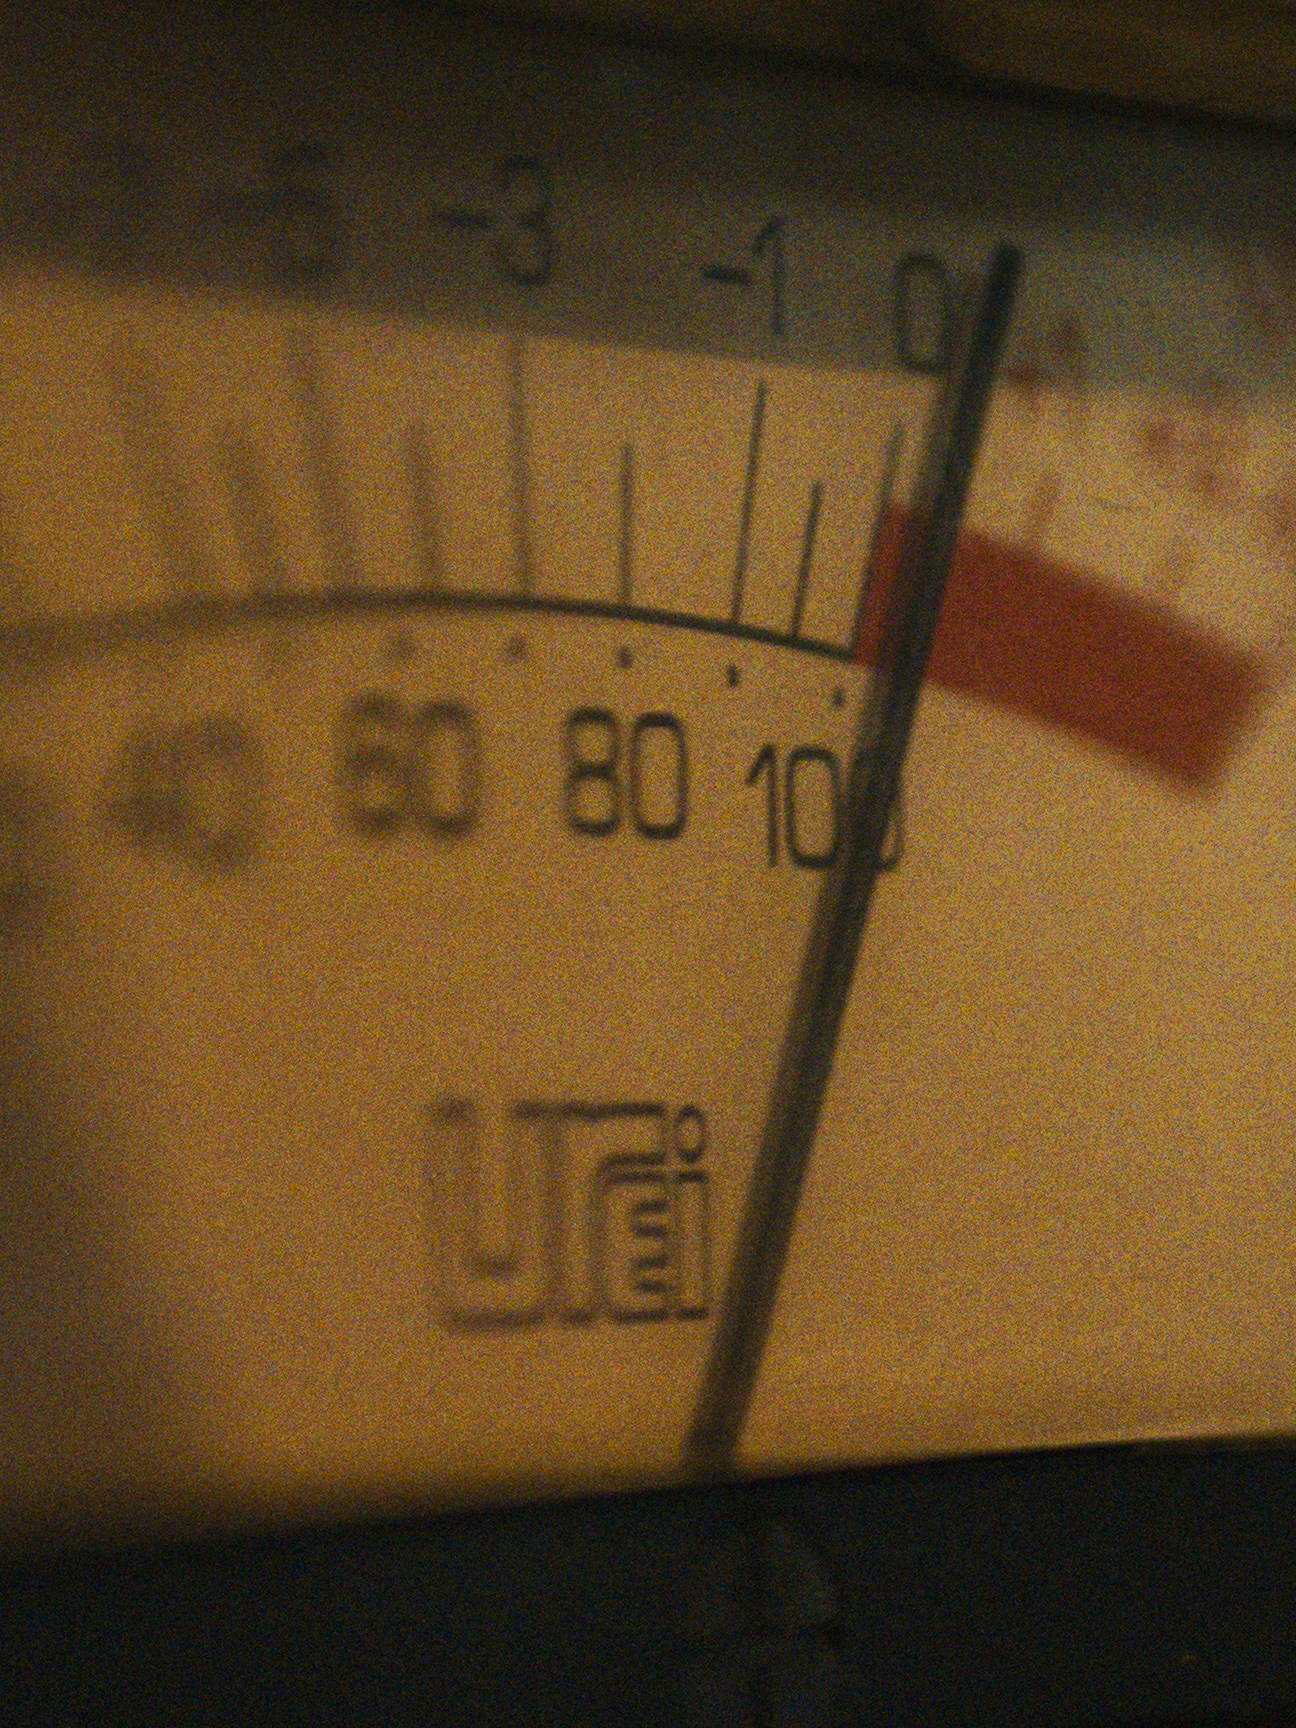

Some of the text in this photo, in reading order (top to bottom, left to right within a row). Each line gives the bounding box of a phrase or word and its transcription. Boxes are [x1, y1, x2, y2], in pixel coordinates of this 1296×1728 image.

[432, 154, 556, 288] -3
[705, 215, 786, 338] -1
[337, 690, 484, 842] 60
[564, 706, 688, 842] 80
